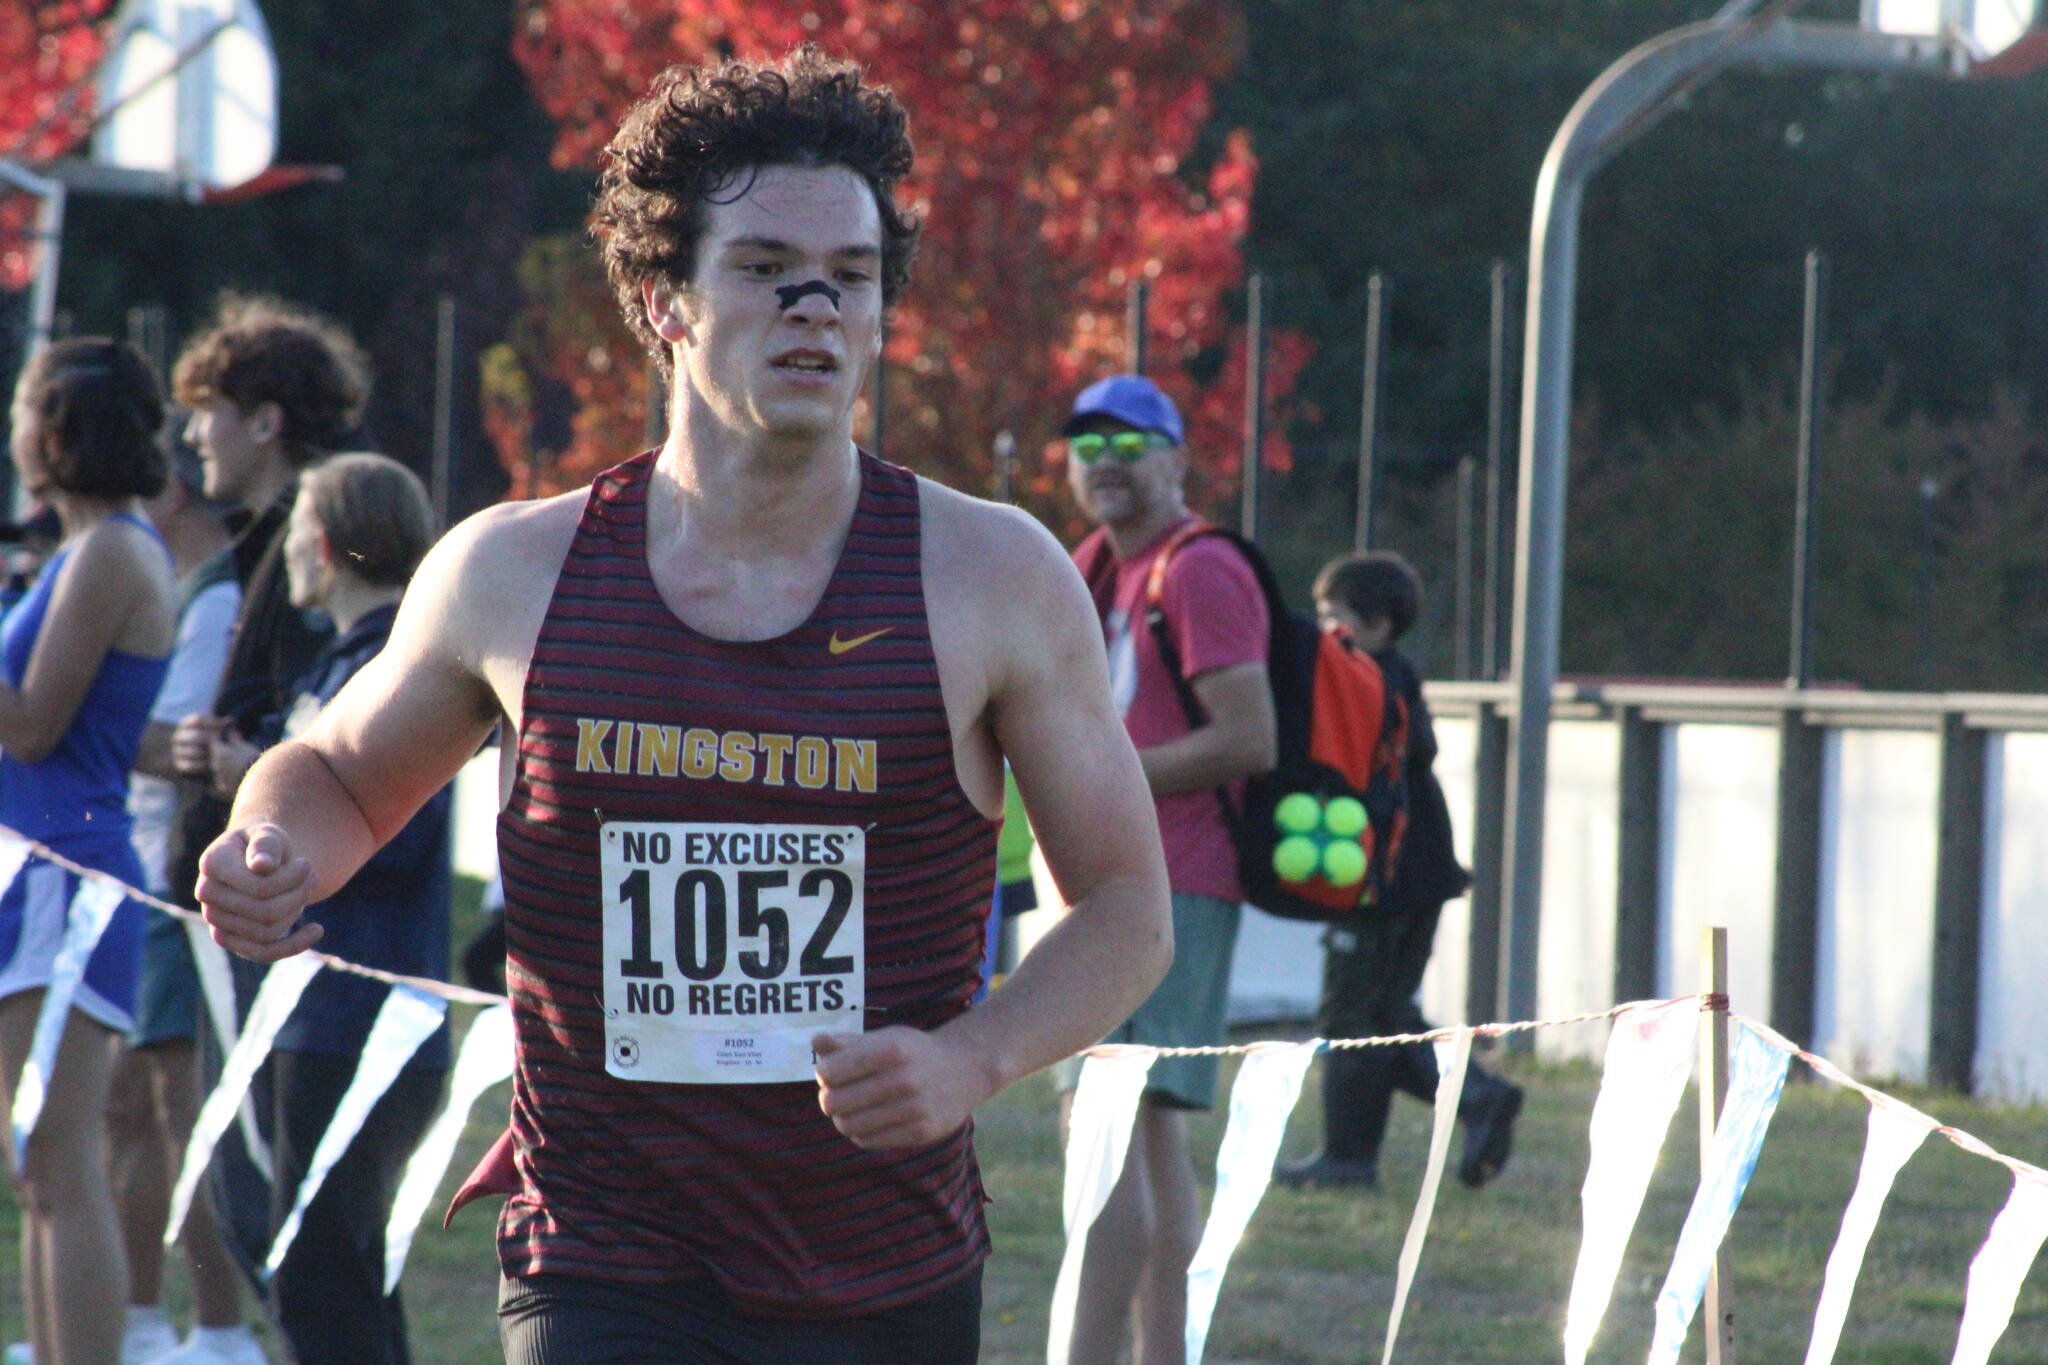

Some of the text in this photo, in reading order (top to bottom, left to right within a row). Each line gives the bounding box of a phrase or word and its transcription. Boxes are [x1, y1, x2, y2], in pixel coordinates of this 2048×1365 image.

[576, 718, 877, 793] KINGSTON
[623, 831, 845, 865] NO EXCUSES
[619, 868, 854, 981] 1052
[627, 980, 844, 1015] NO REGRETS
[724, 1038, 754, 1048] #1052
